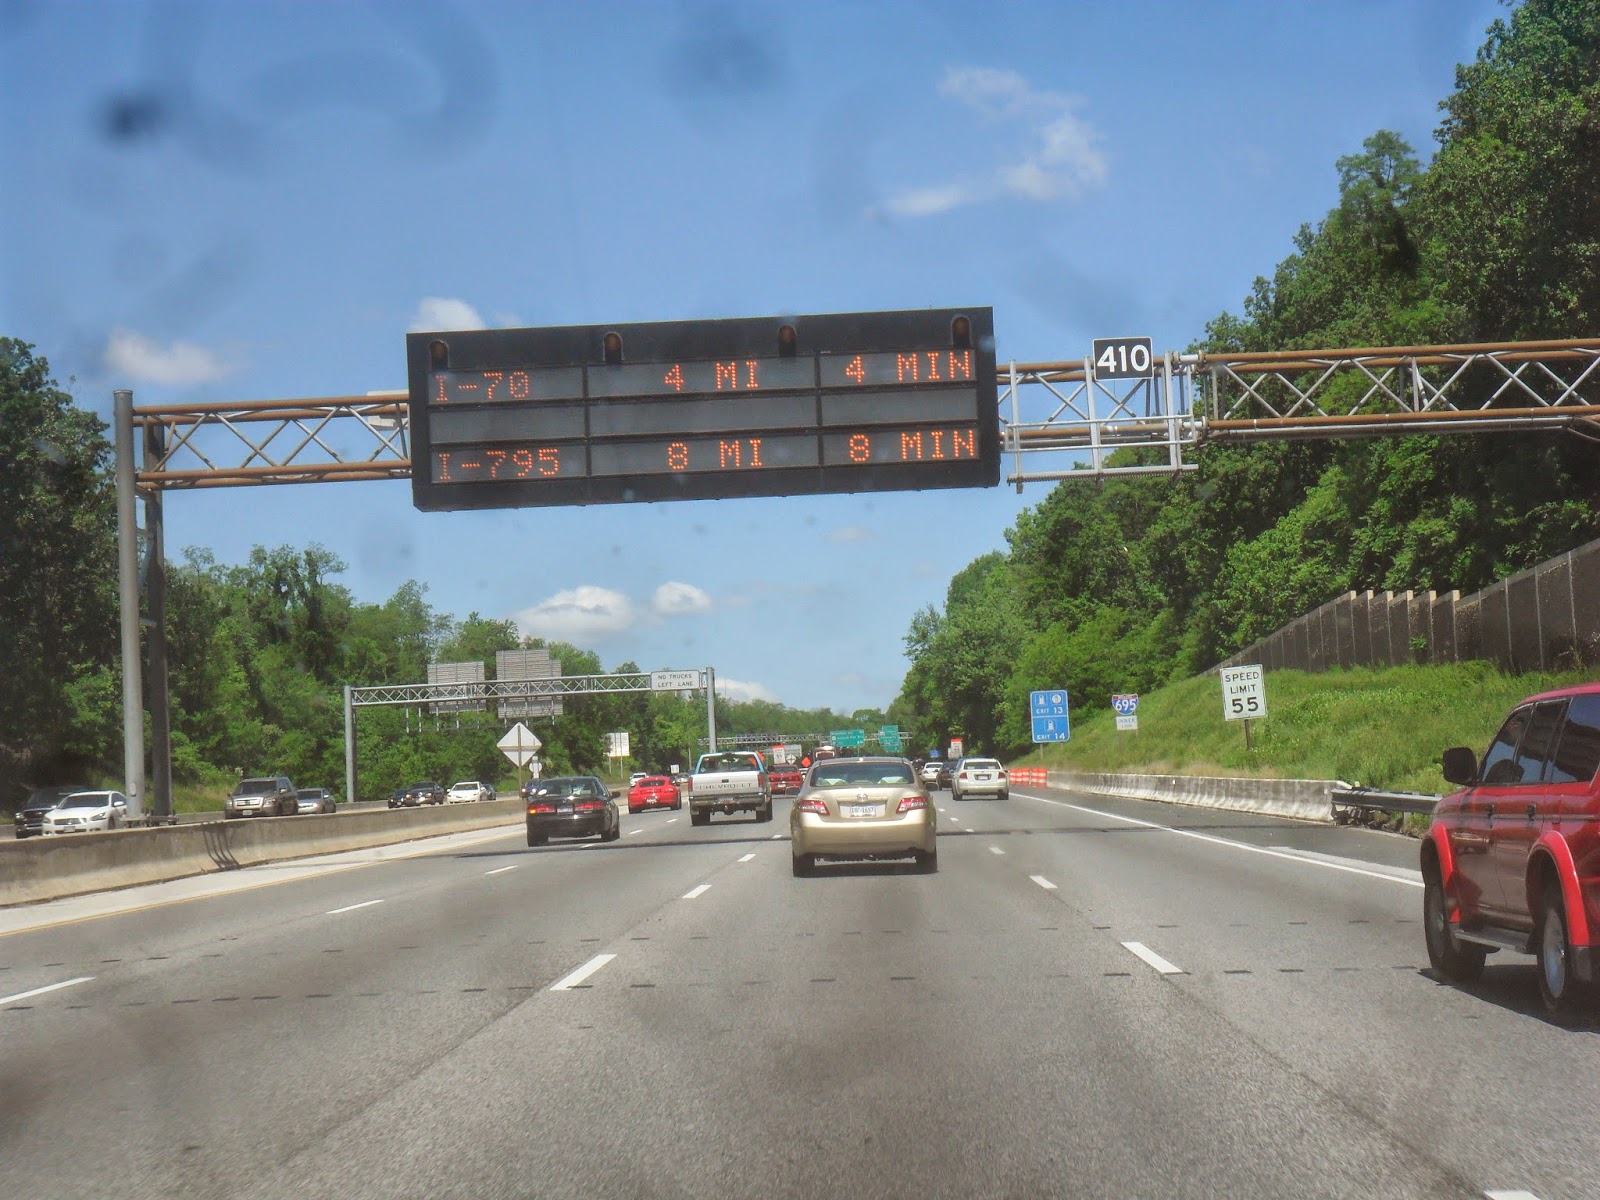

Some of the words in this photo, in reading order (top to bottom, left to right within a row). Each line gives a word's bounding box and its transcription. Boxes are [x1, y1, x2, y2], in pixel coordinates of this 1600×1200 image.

[1097, 344, 1150, 373] 410
[435, 371, 529, 401] I-70
[664, 364, 685, 392] 4
[716, 360, 760, 390] MI
[845, 355, 865, 383] 4
[897, 351, 971, 381] MIN
[438, 448, 560, 480] I-795
[667, 442, 688, 470] 8
[720, 438, 763, 468] MI
[849, 434, 870, 462] 8
[901, 429, 975, 460] MIN
[1225, 671, 1260, 683] SPEED
[1230, 683, 1257, 694] LIMIT
[1053, 706, 1063, 714] 13
[1115, 698, 1137, 711] 695
[1231, 696, 1259, 714] 55
[1055, 732, 1065, 740] 14
